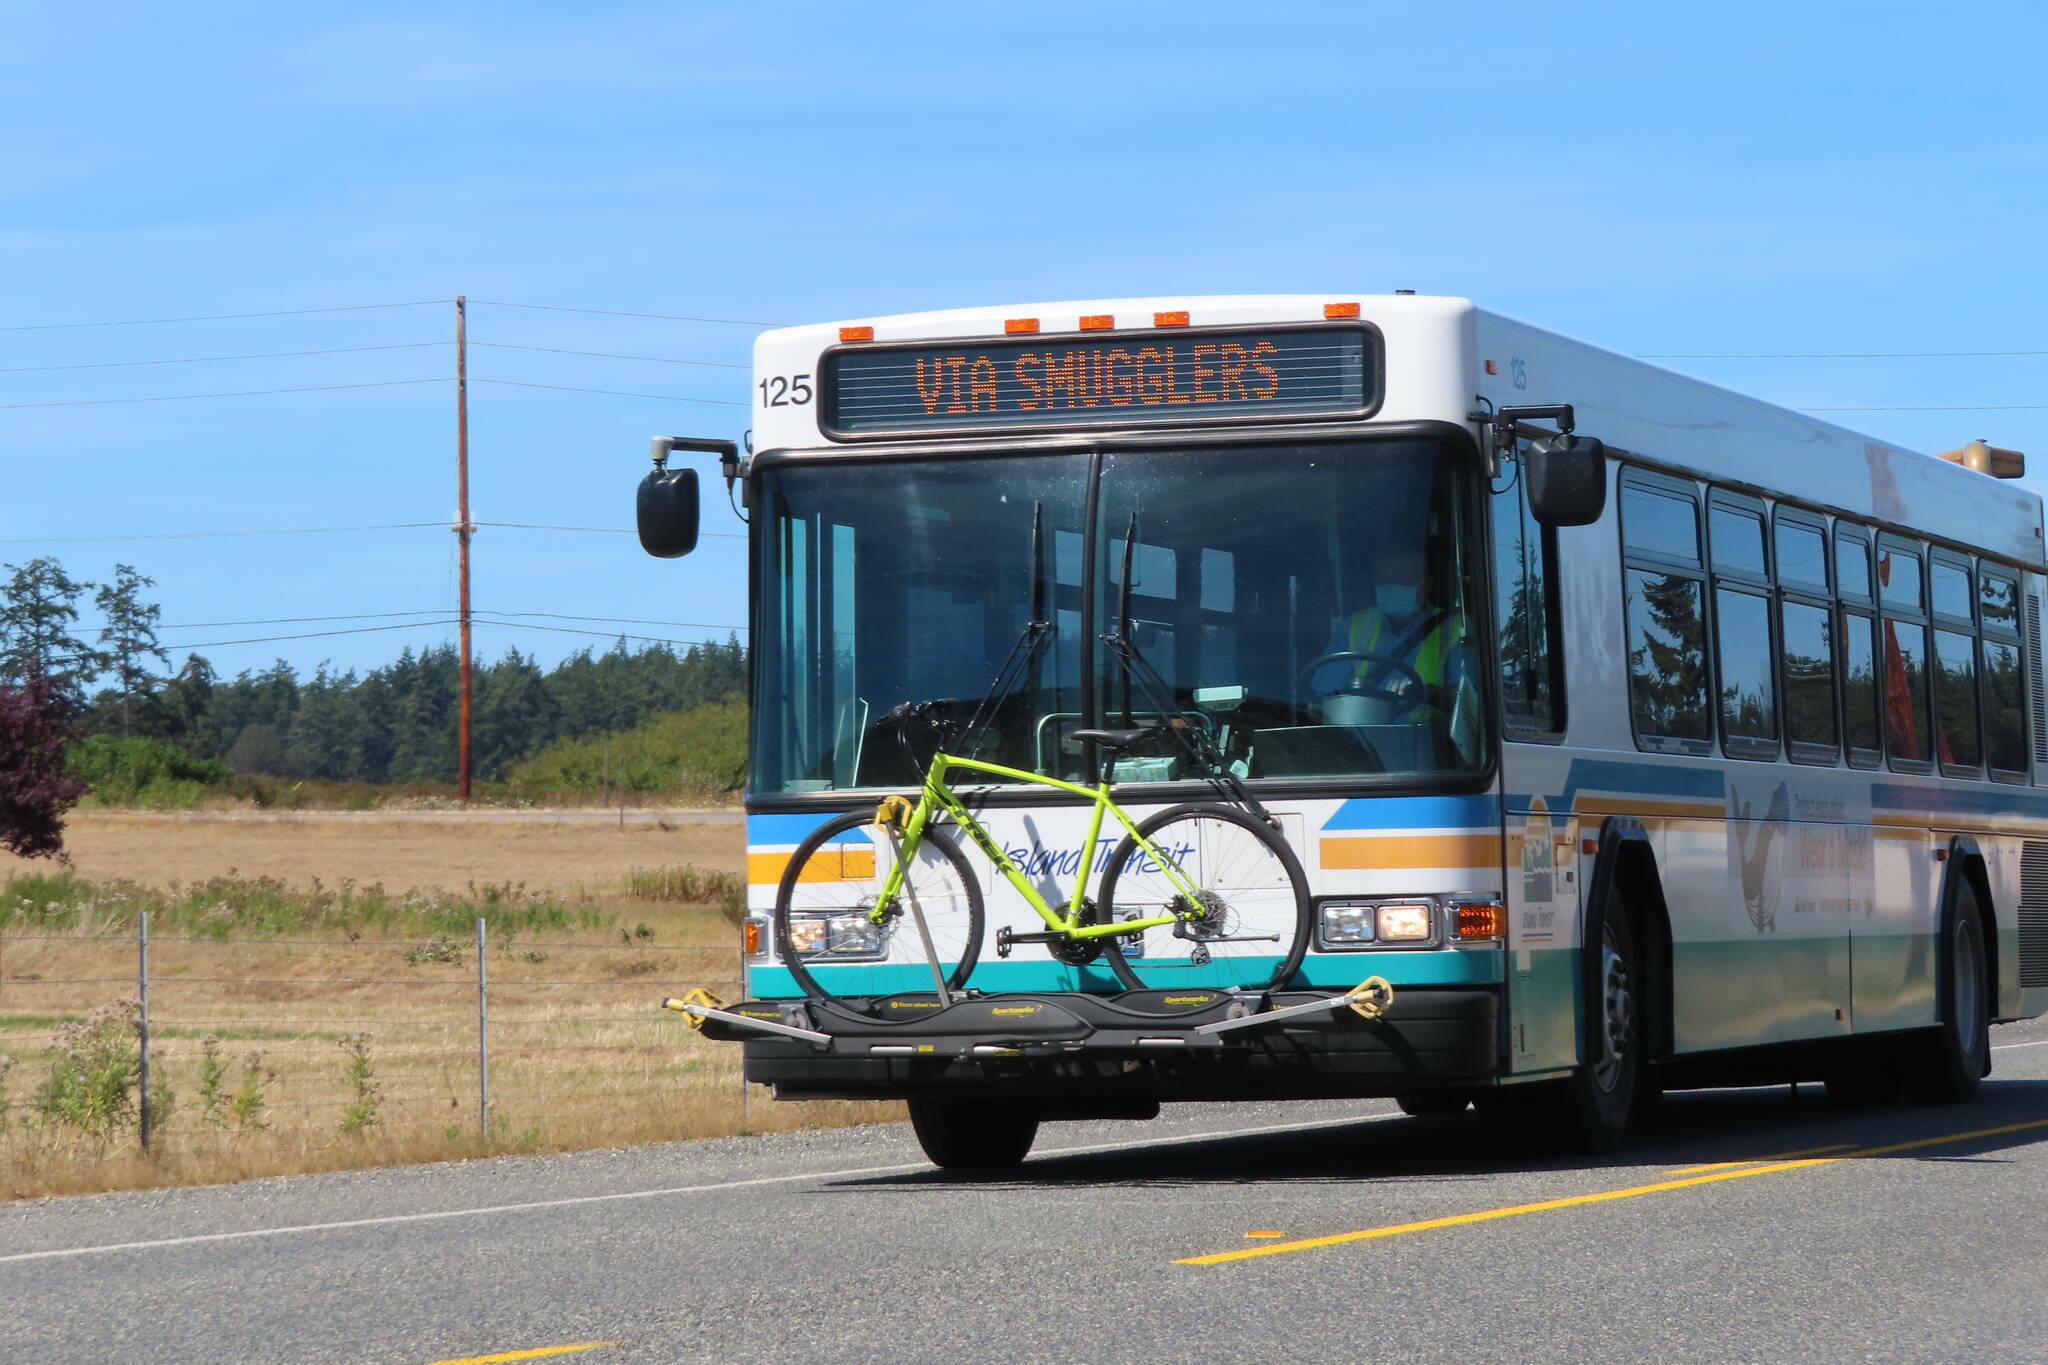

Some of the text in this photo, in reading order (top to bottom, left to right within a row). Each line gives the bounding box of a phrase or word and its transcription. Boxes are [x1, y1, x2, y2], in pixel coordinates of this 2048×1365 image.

[759, 374, 812, 408] 125
[916, 341, 1279, 414] VIA SMUGGLERS
[1510, 356, 1527, 391] 125
[951, 804, 1016, 873] TREK
[995, 838, 1195, 876] Island Trnsit
